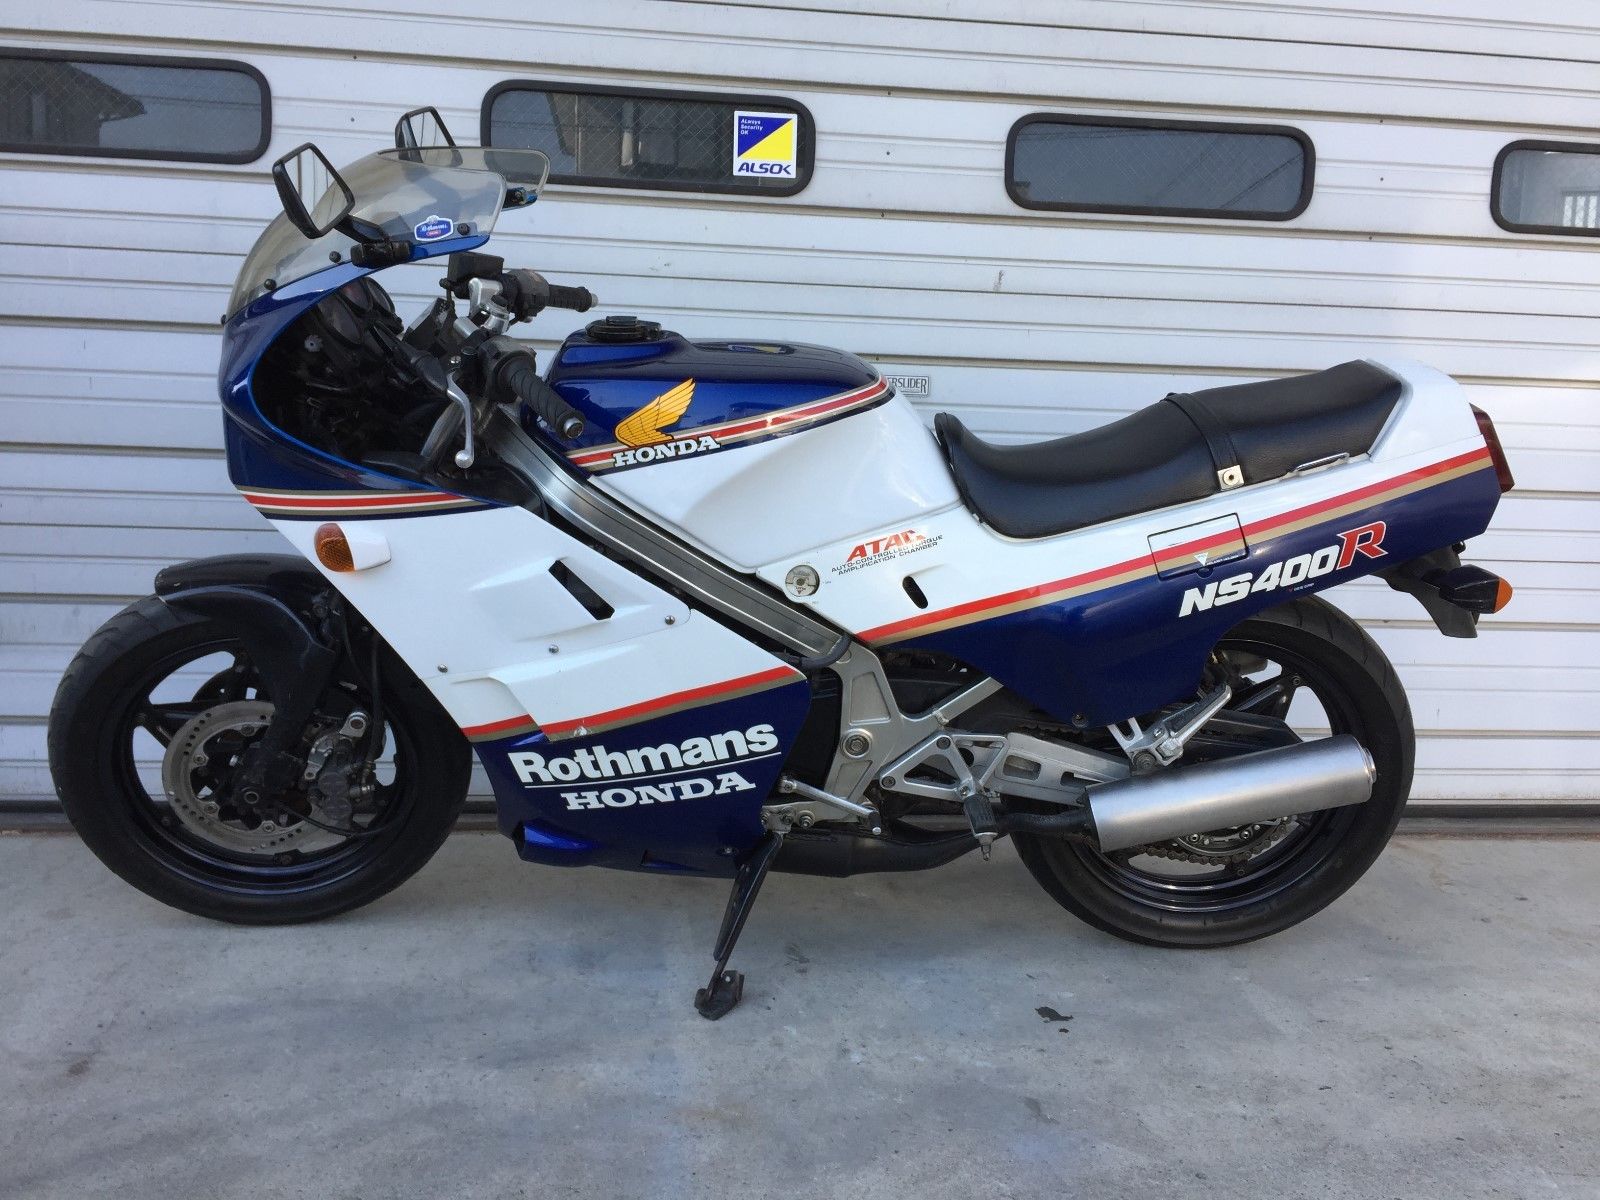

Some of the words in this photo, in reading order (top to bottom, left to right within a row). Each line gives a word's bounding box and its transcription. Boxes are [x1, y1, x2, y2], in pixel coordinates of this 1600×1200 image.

[738, 162, 791, 175] ALSOK
[613, 435, 720, 467] HONDA
[838, 554, 896, 575] AMPLIFICATION
[899, 542, 938, 557] CHAMBER
[1178, 520, 1389, 618] NS400R
[508, 723, 779, 783] Rothmans
[559, 771, 756, 810] HONDA
